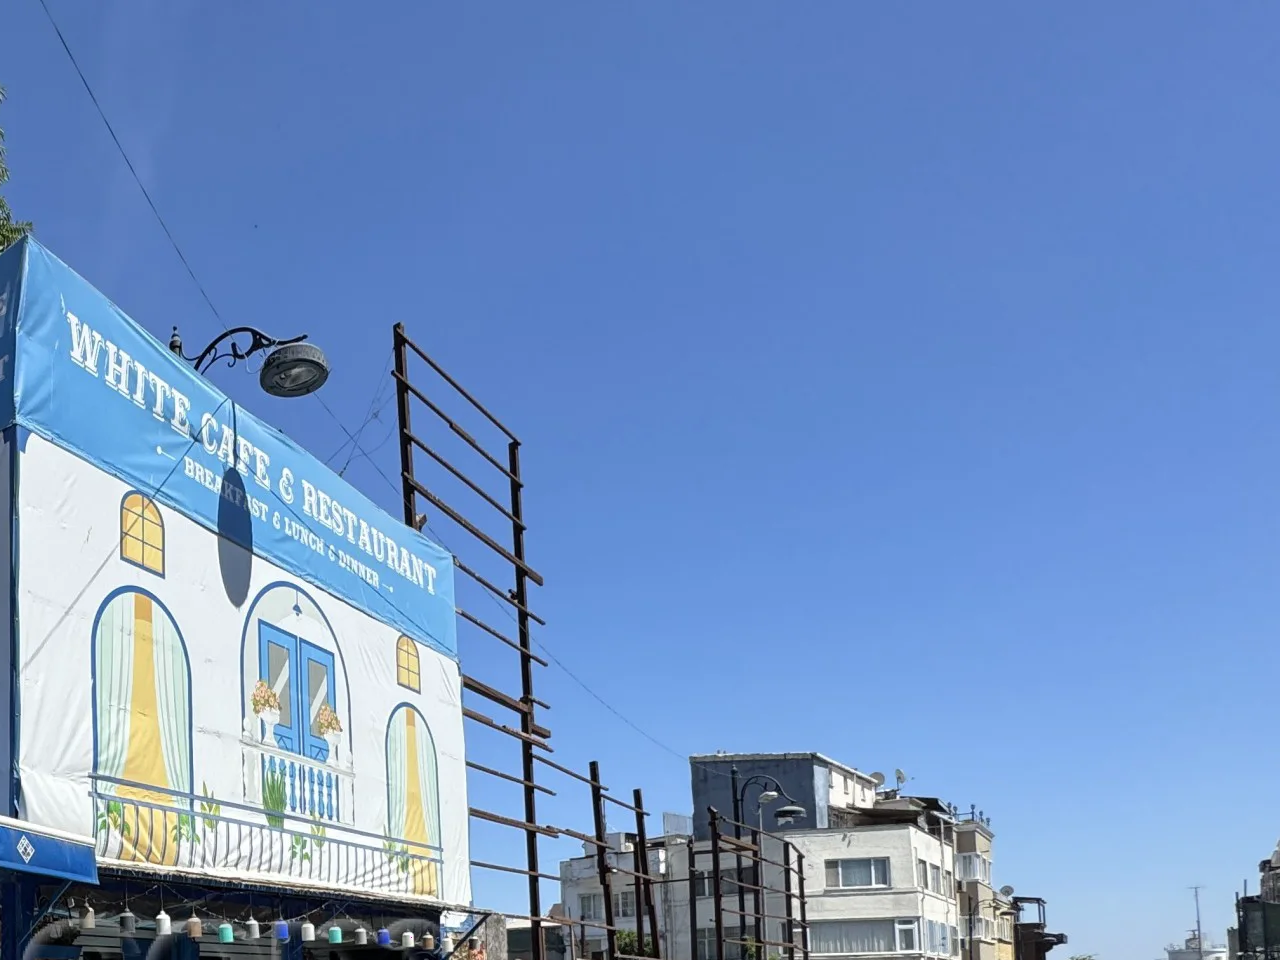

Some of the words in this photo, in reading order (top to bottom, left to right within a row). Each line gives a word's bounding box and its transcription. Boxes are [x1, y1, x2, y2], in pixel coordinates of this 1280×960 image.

[67, 311, 190, 439] WHITE
[200, 412, 270, 489] CAFE
[279, 467, 295, 505] &
[302, 479, 437, 595] RESTAURANT
[184, 456, 268, 522] BREAKFAST
[272, 511, 281, 530] &
[284, 517, 325, 556] LUNCH
[338, 550, 380, 588] DINNER
